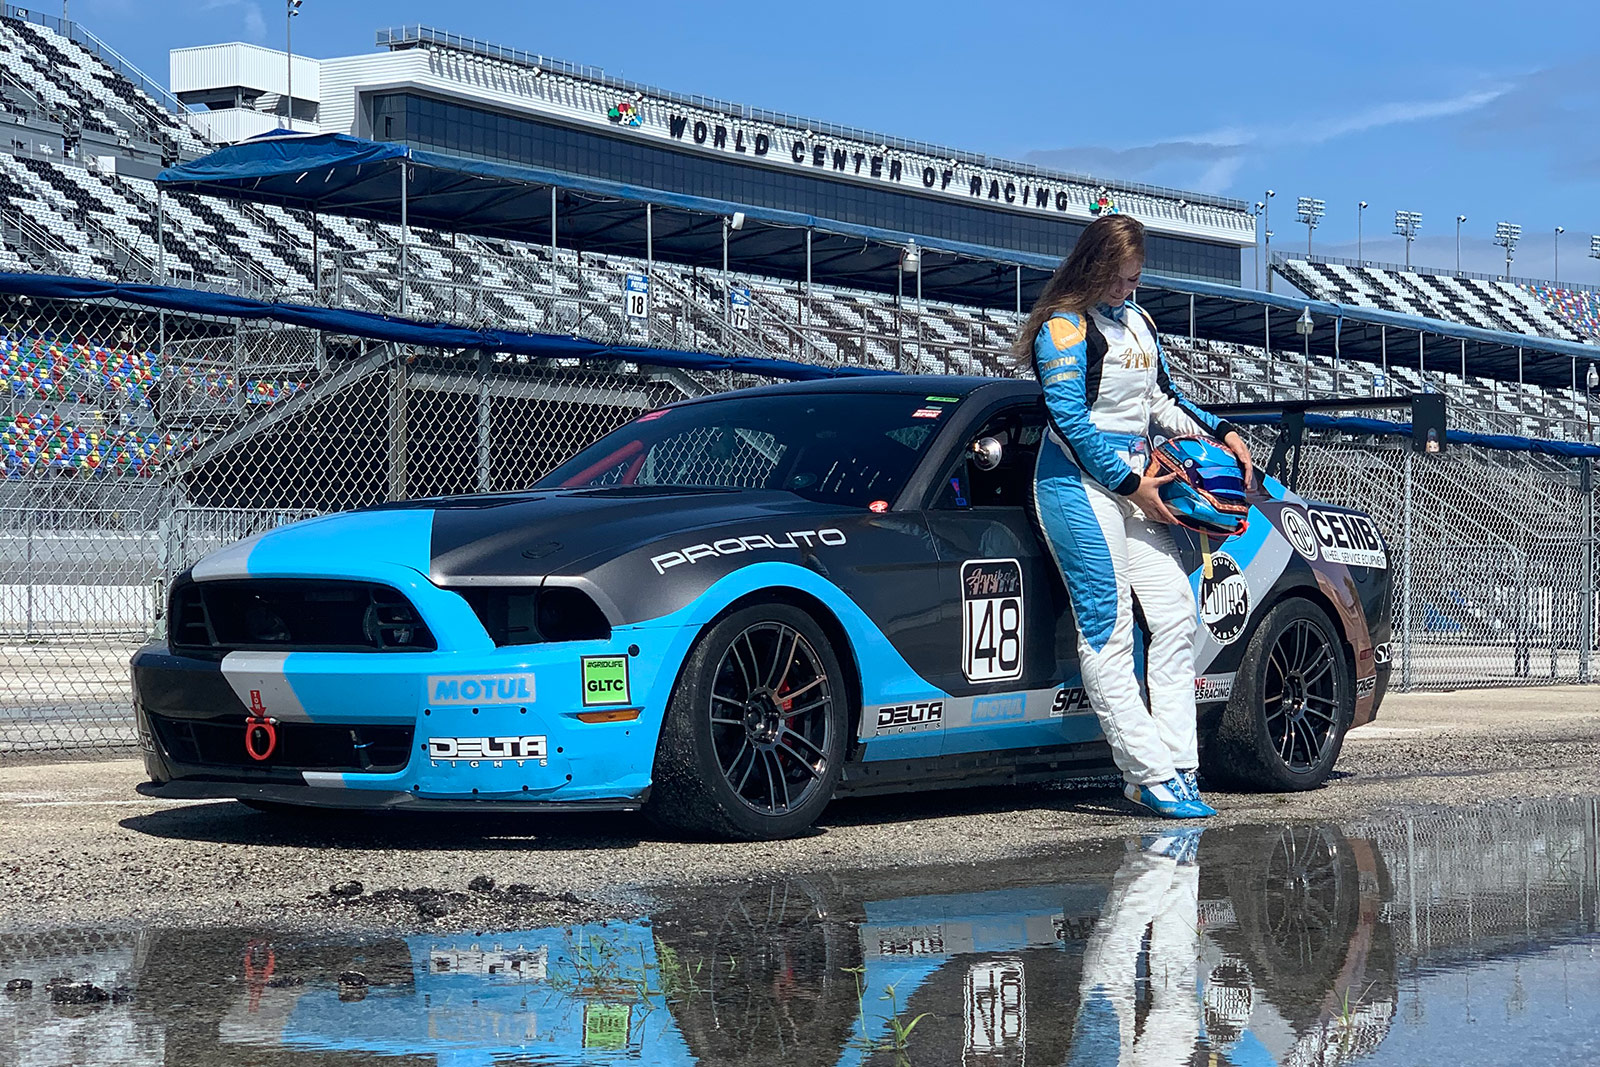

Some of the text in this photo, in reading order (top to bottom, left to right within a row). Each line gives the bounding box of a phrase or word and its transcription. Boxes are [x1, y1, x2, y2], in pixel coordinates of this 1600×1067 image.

[669, 114, 1068, 212] WORLD CENTER OF RACING
[631, 295, 644, 315] 18
[735, 307, 746, 326] 17
[1310, 511, 1379, 551] CEMB
[650, 528, 847, 575] PROAUTO
[1212, 558, 1235, 571] OUND
[1204, 582, 1245, 615] LUNA'S
[968, 599, 1019, 675] 148
[1212, 625, 1239, 639] TABLE
[434, 678, 531, 700] MOTUL
[587, 679, 623, 692] GLTC
[1195, 679, 1206, 689] NE
[253, 691, 261, 710] TOW
[976, 698, 1023, 719] MOTUL
[1052, 688, 1092, 711] SPE
[878, 702, 943, 726] DELTA
[876, 723, 941, 736] LIGHTS
[429, 735, 547, 757] DELTA
[431, 759, 548, 768] LIGHTS
